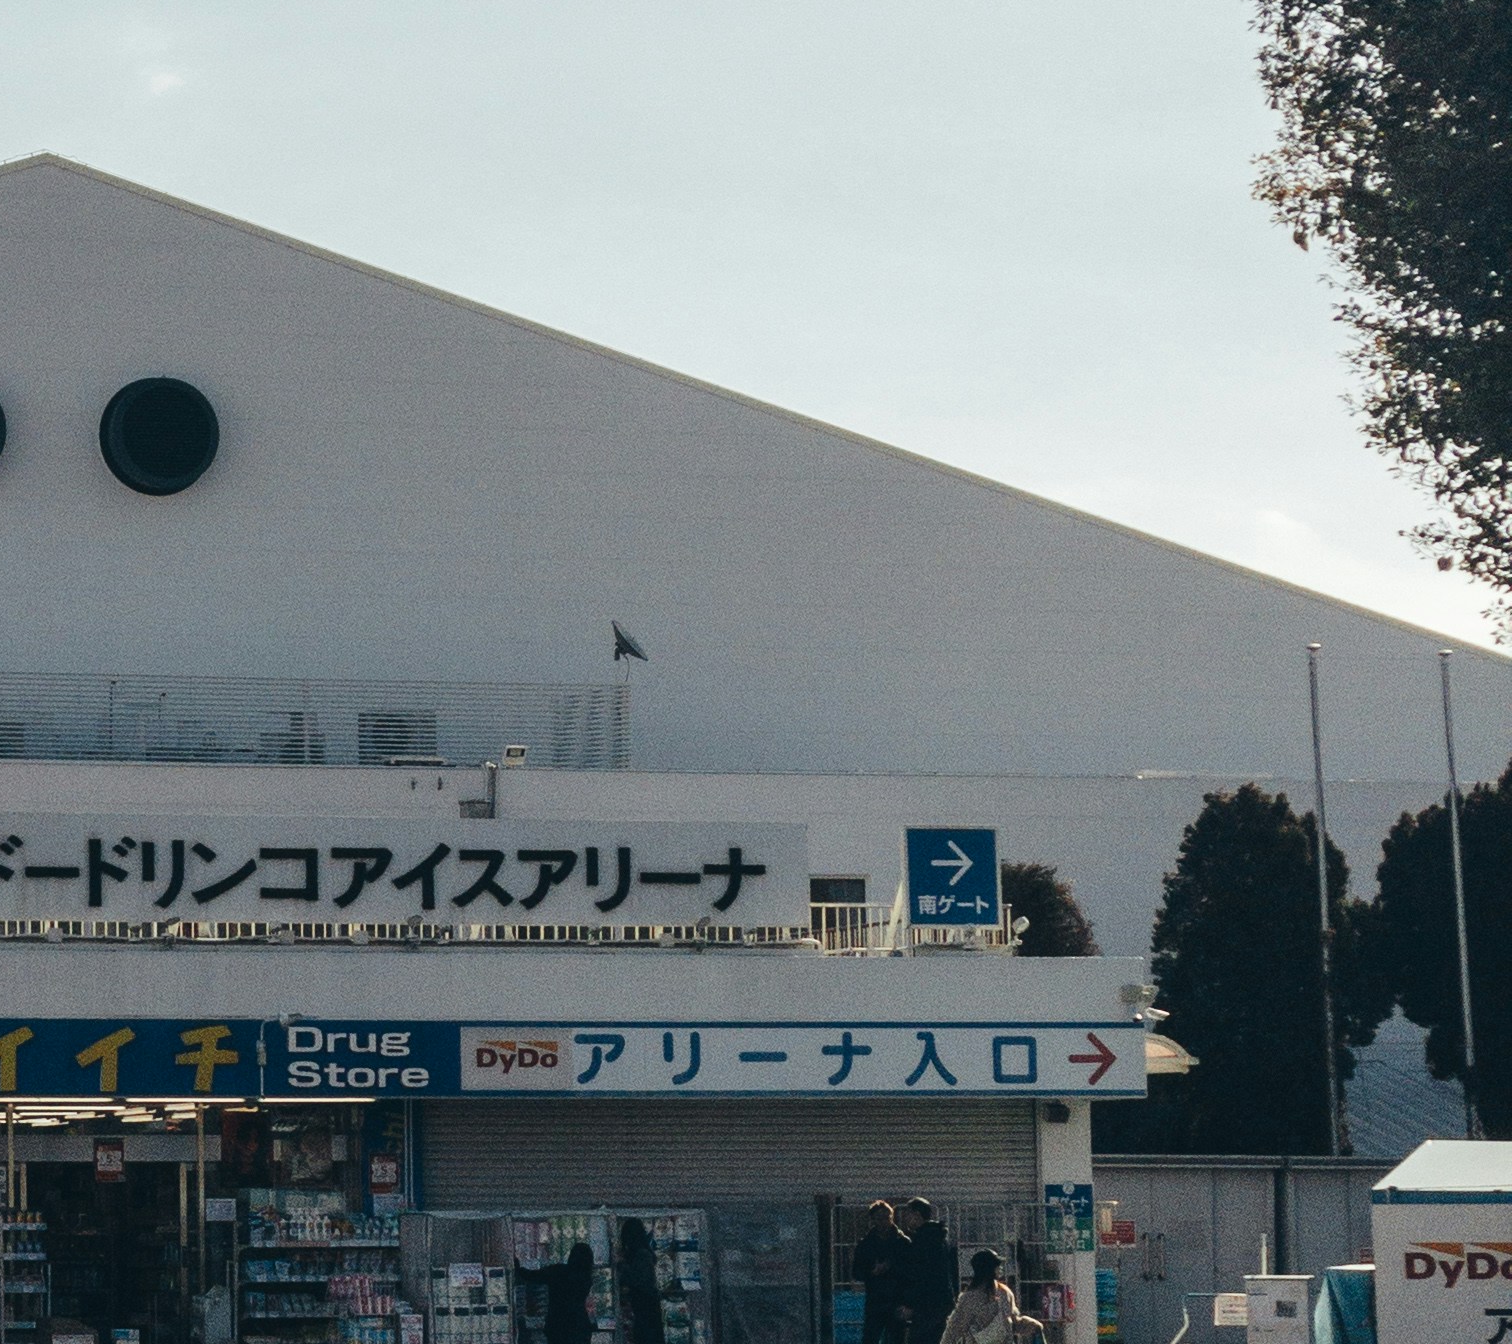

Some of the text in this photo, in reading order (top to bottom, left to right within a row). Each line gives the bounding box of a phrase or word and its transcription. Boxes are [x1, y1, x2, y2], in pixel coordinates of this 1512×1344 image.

[918, 894, 989, 915] 南ゲート
[288, 1026, 410, 1057] Drug
[476, 1031, 1037, 1087] DyDo アリーナ入口
[288, 1061, 429, 1088] Store
